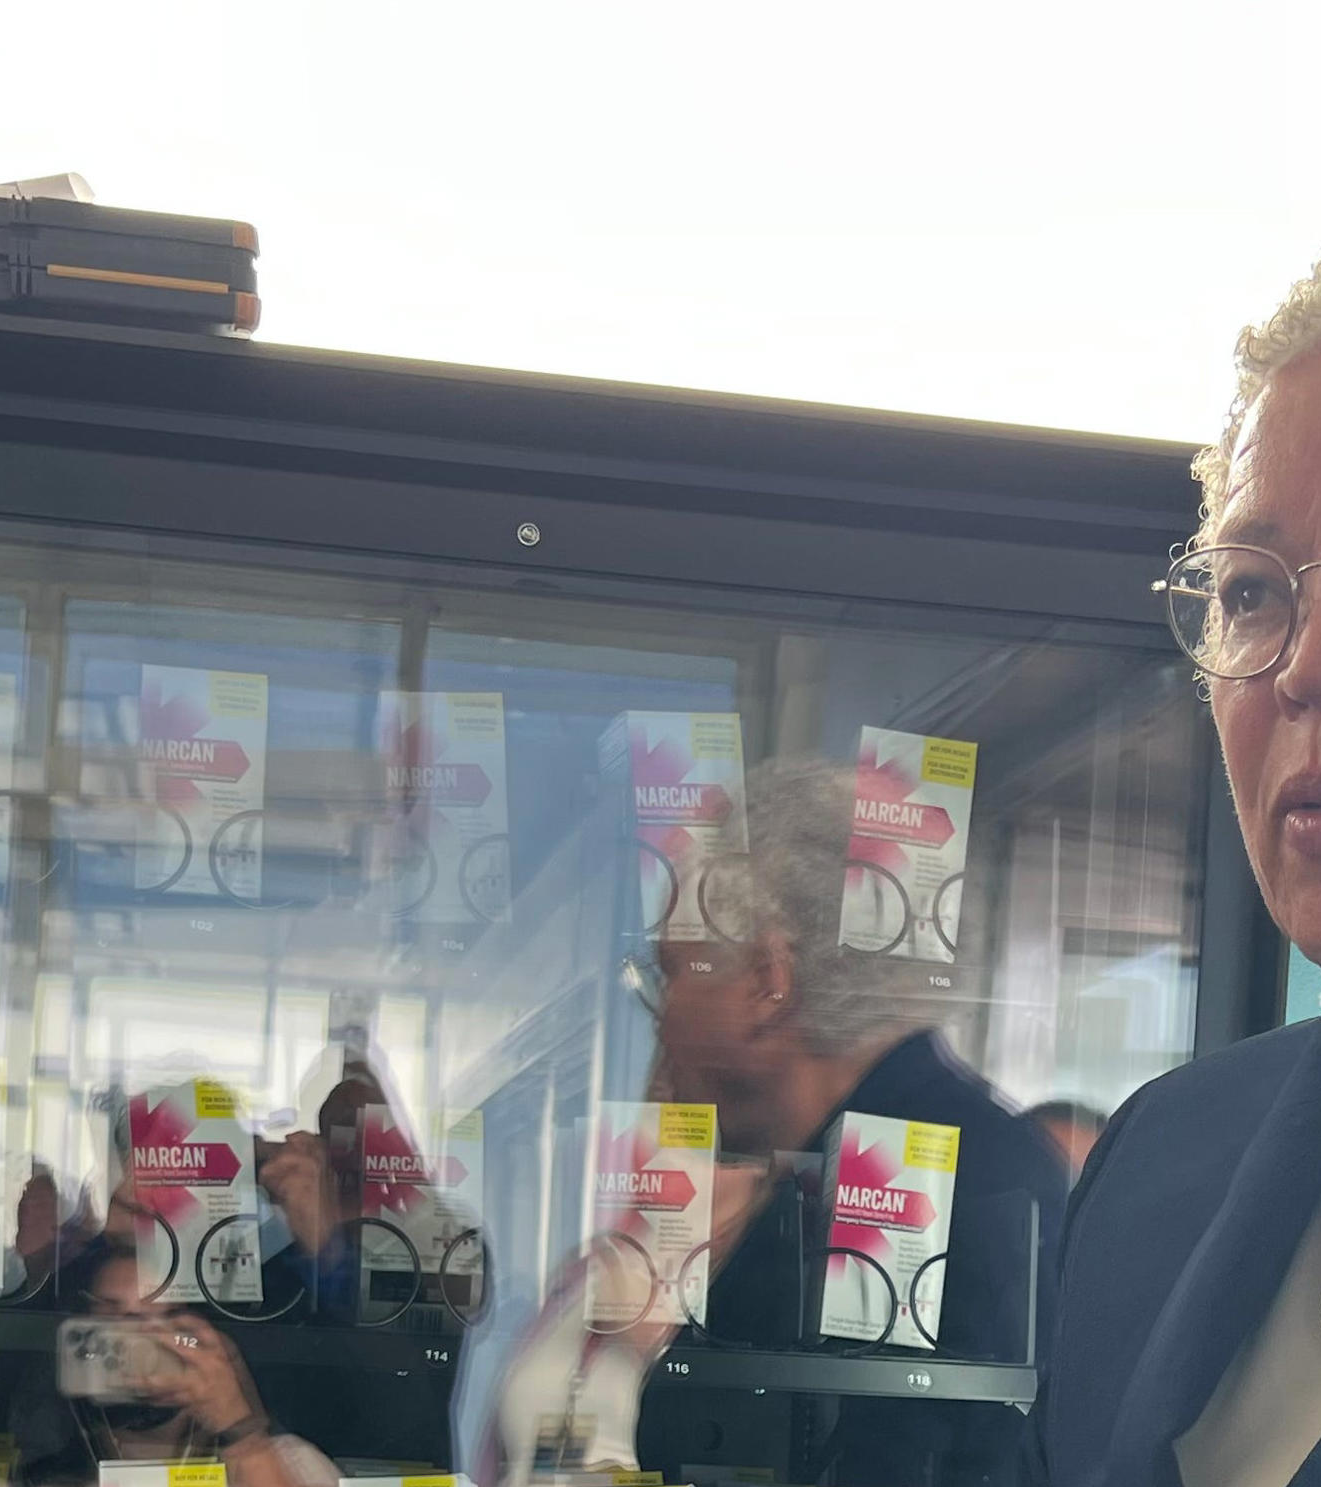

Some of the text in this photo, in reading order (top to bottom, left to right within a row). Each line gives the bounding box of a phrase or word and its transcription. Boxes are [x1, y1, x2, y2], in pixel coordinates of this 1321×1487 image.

[142, 738, 215, 763] NARCAN
[387, 765, 458, 790] NARCAN
[635, 785, 703, 809] NARCAN
[853, 799, 923, 828] NARCAN
[689, 961, 712, 973] 106
[928, 976, 951, 988] 108
[134, 1145, 207, 1169] NARCAN
[366, 1154, 436, 1173] NARCAN
[595, 1171, 663, 1194] NARCAN
[836, 1184, 905, 1214] NARCAN
[173, 1335, 198, 1348] 112
[424, 1349, 449, 1363] 114
[665, 1362, 690, 1375] 116
[907, 1373, 931, 1387] 118
